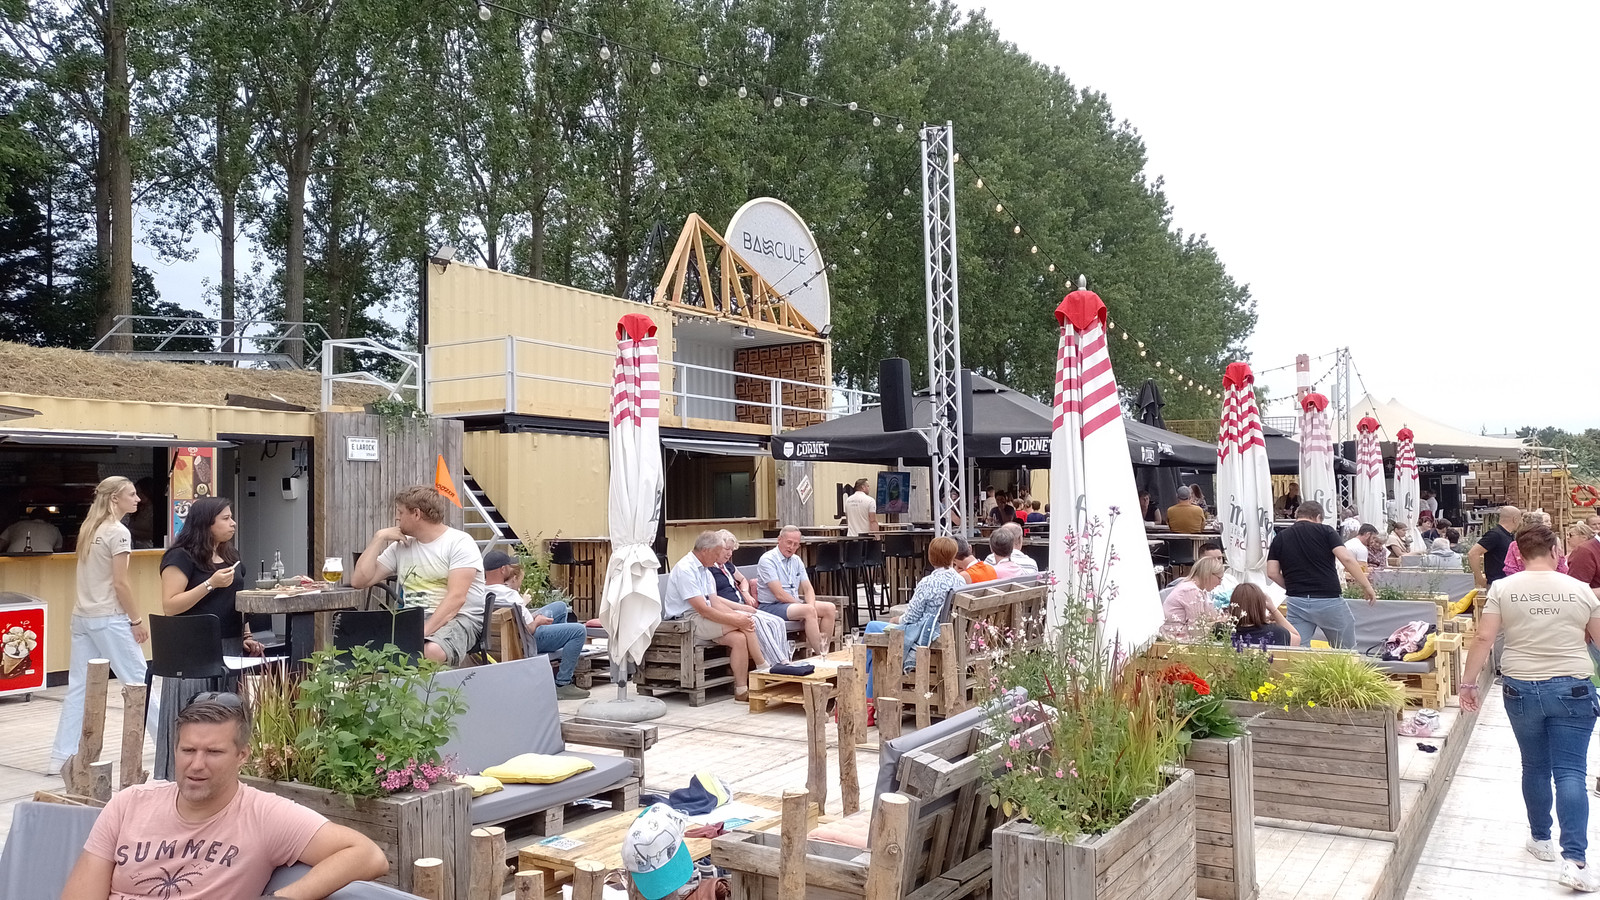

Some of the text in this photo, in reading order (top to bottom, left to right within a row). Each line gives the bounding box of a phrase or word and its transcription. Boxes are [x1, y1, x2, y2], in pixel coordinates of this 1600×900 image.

[796, 442, 830, 456] CORNET
[1529, 607, 1560, 615] CREW
[116, 839, 239, 867] SUMMER
